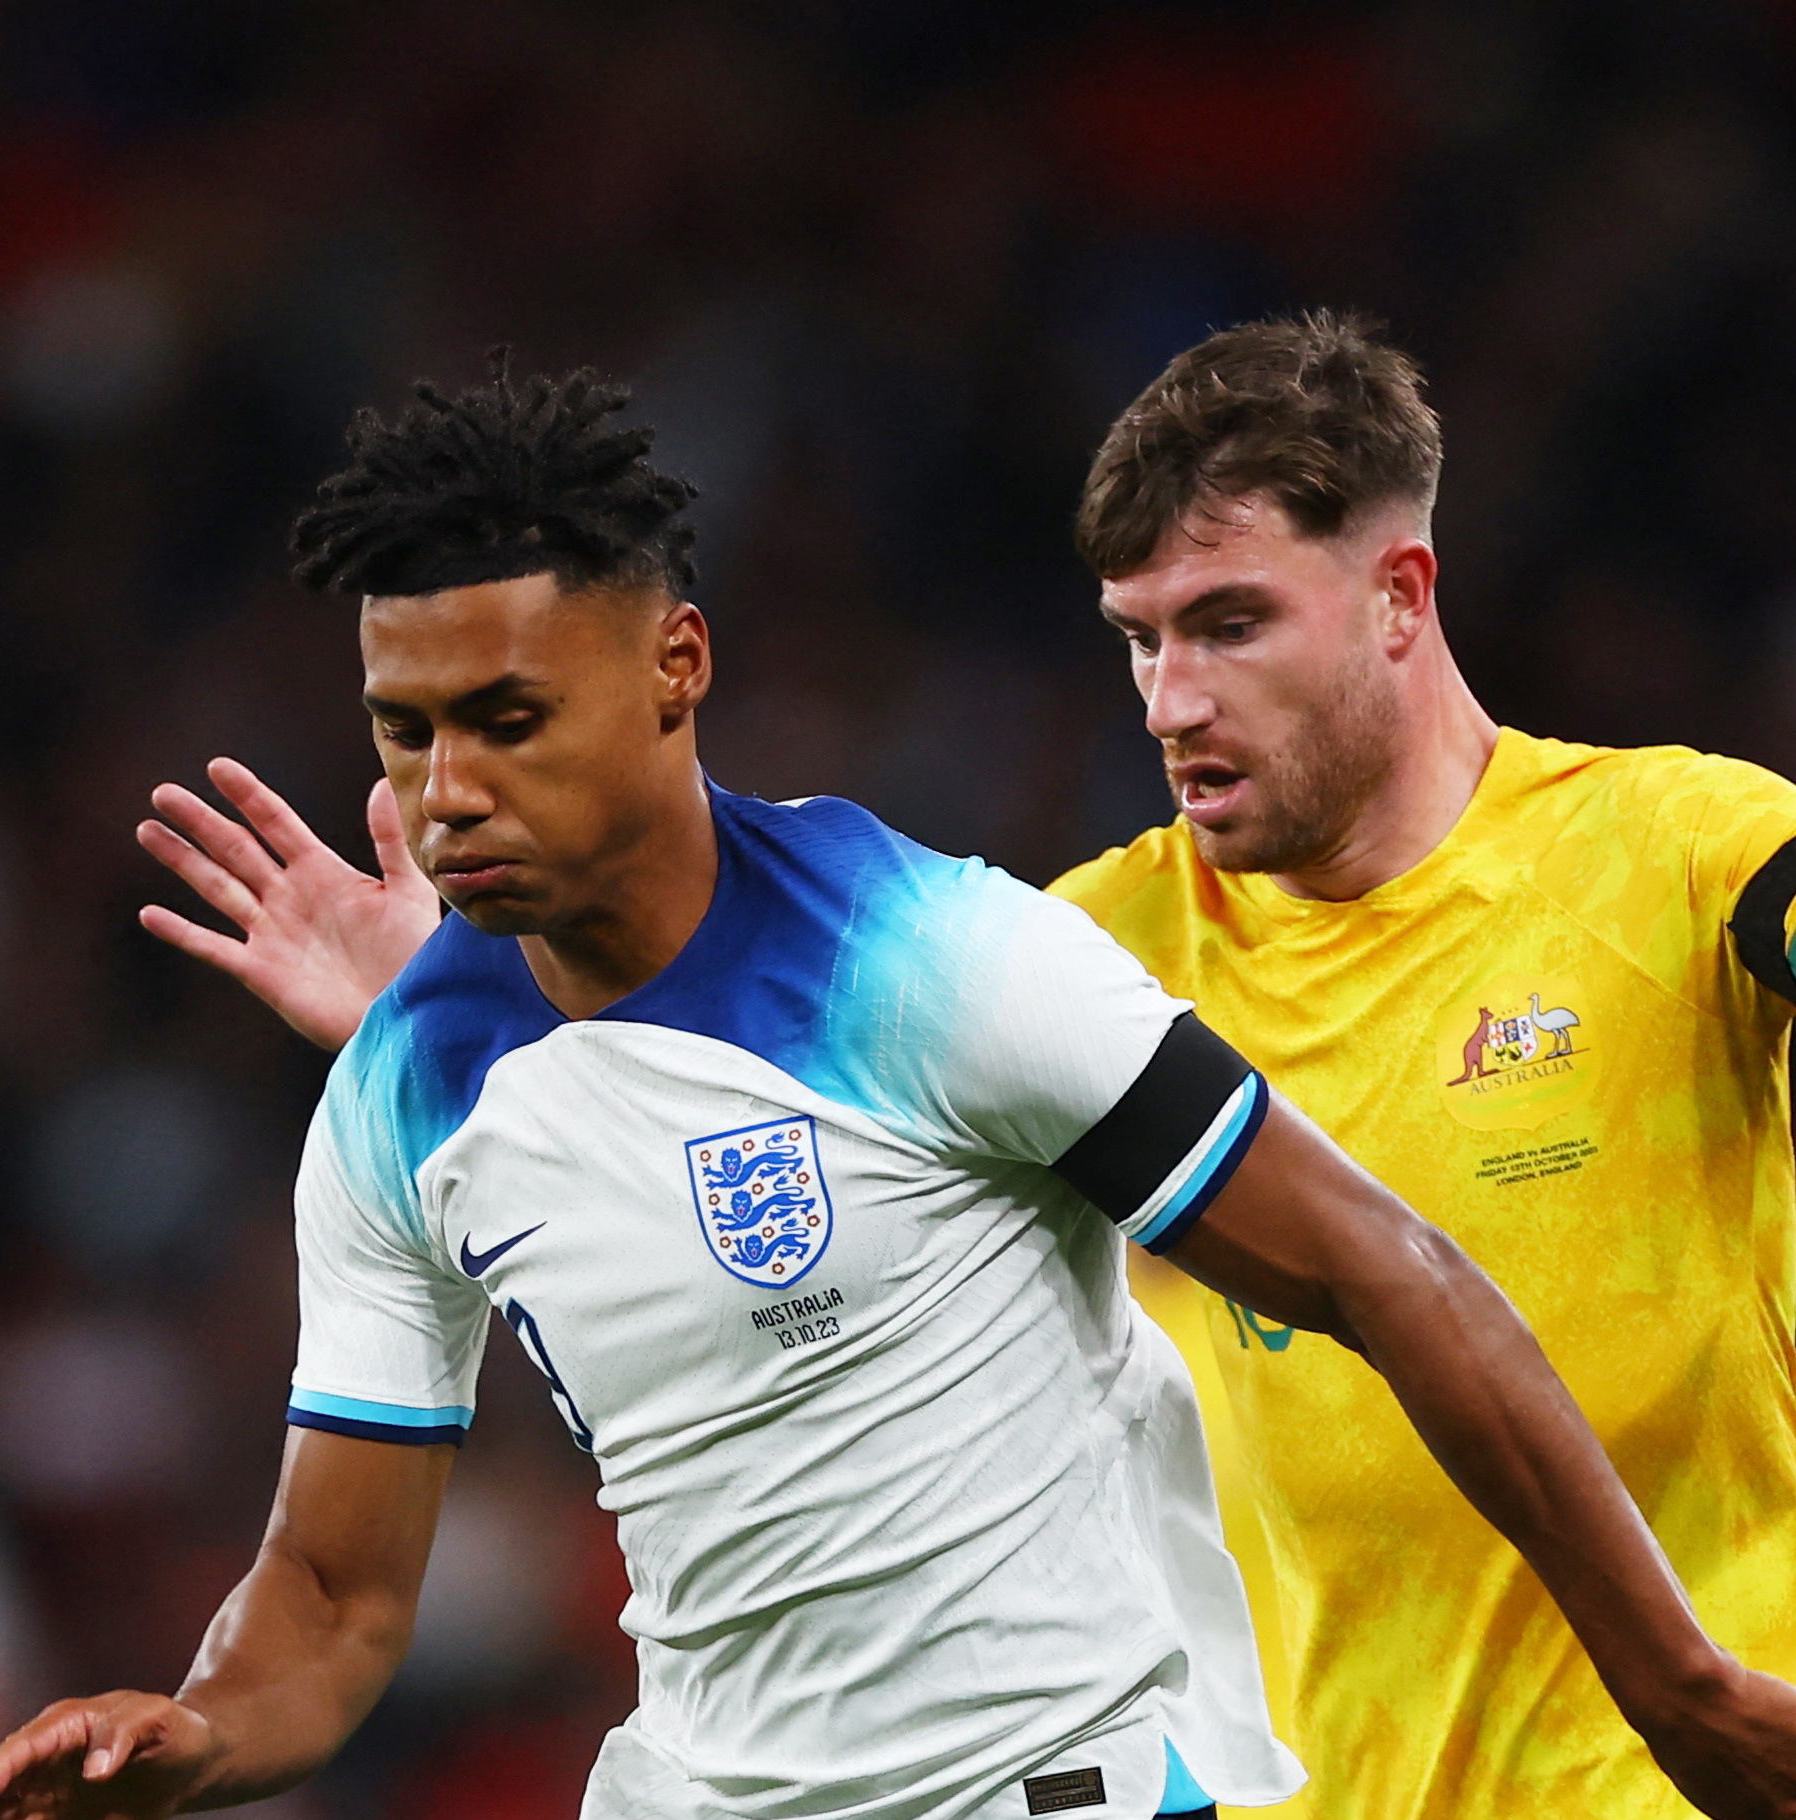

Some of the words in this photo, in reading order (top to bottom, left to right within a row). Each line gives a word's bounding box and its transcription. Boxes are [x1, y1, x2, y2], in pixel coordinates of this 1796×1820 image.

[1469, 1058, 1574, 1096] AUSTRALIA
[1476, 1167, 1508, 1179] FRIDAY
[1534, 1152, 1578, 1167] OCTOBER
[1482, 1152, 1525, 1167] ENGLAND
[1540, 1138, 1589, 1155] AUSTRALIA
[775, 1316, 841, 1351] 13.10.23
